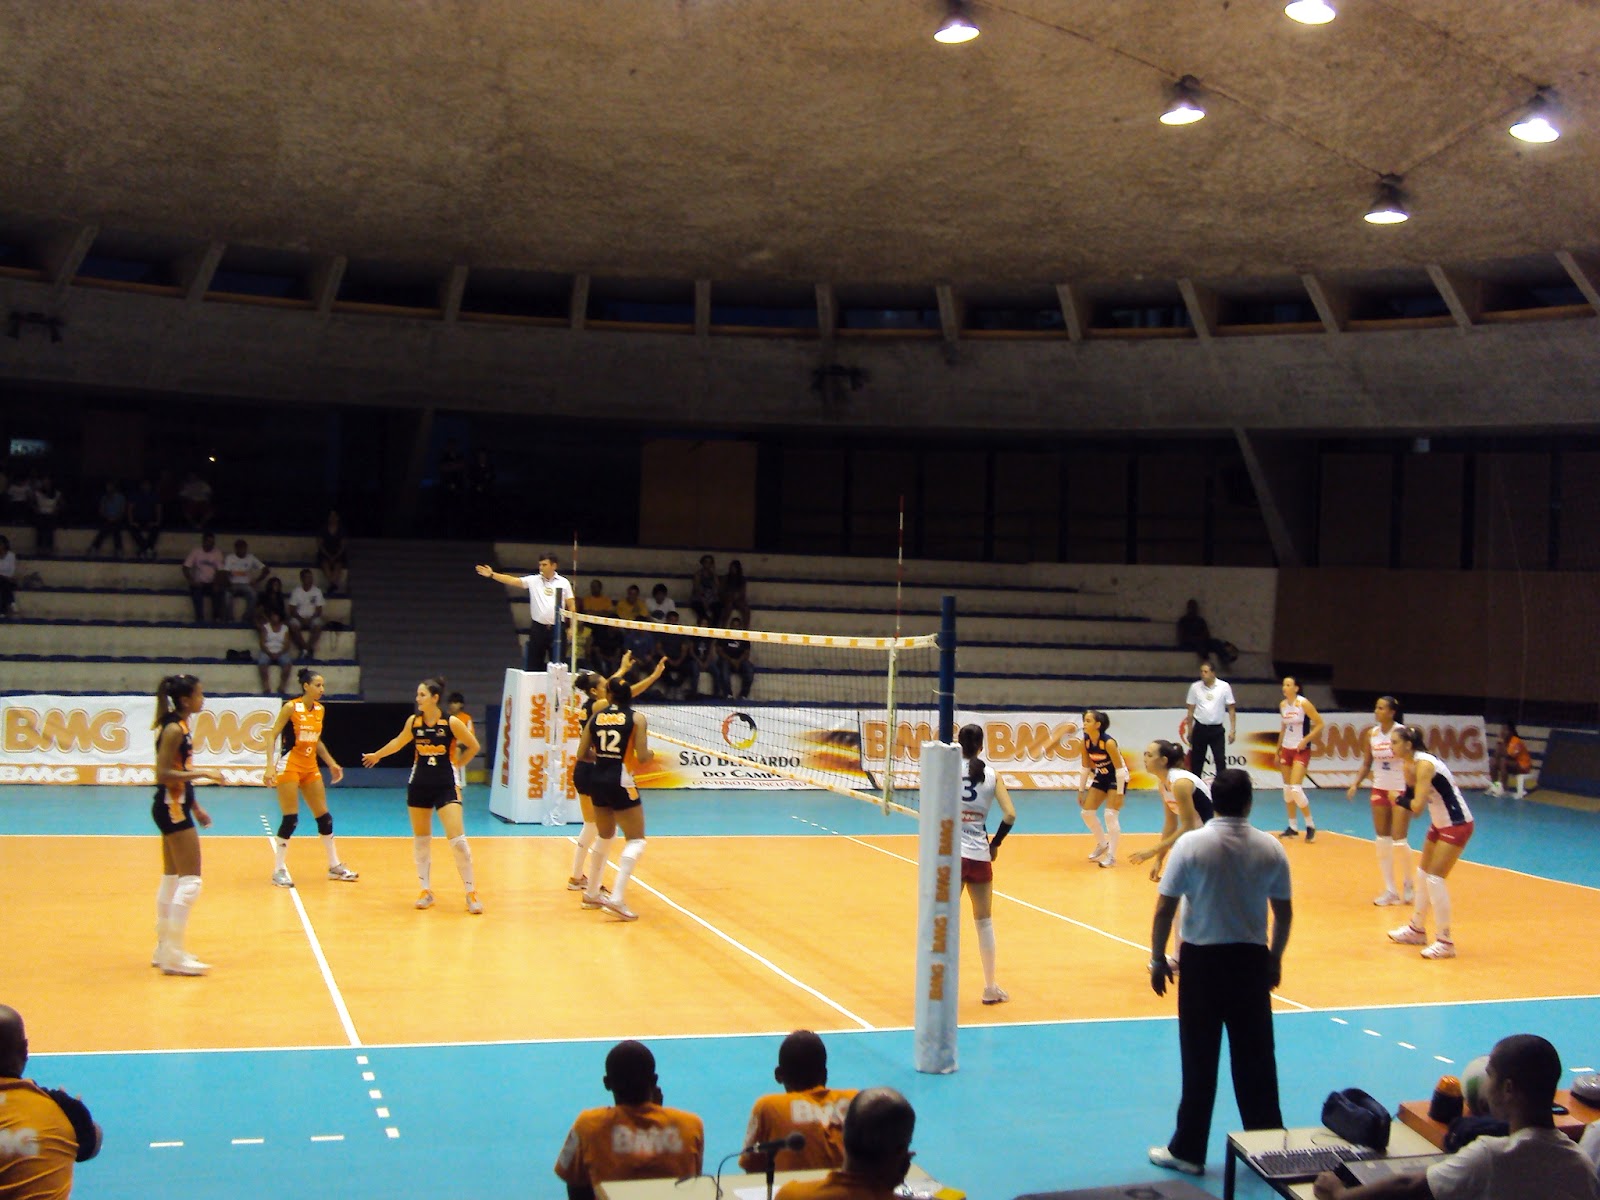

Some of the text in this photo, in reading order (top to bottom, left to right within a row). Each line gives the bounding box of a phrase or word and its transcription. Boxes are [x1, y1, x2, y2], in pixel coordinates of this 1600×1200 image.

[3, 707, 130, 754] BMG
[191, 710, 276, 754] MG
[530, 693, 547, 738] BMG
[596, 729, 621, 753] 12
[679, 751, 711, 767] SÃO
[863, 720, 960, 762] BM
[985, 722, 1081, 762] BMG
[1424, 725, 1484, 761] MG
[96, 767, 156, 783] BM
[528, 754, 544, 799] BMG
[612, 1125, 683, 1154] BMG
